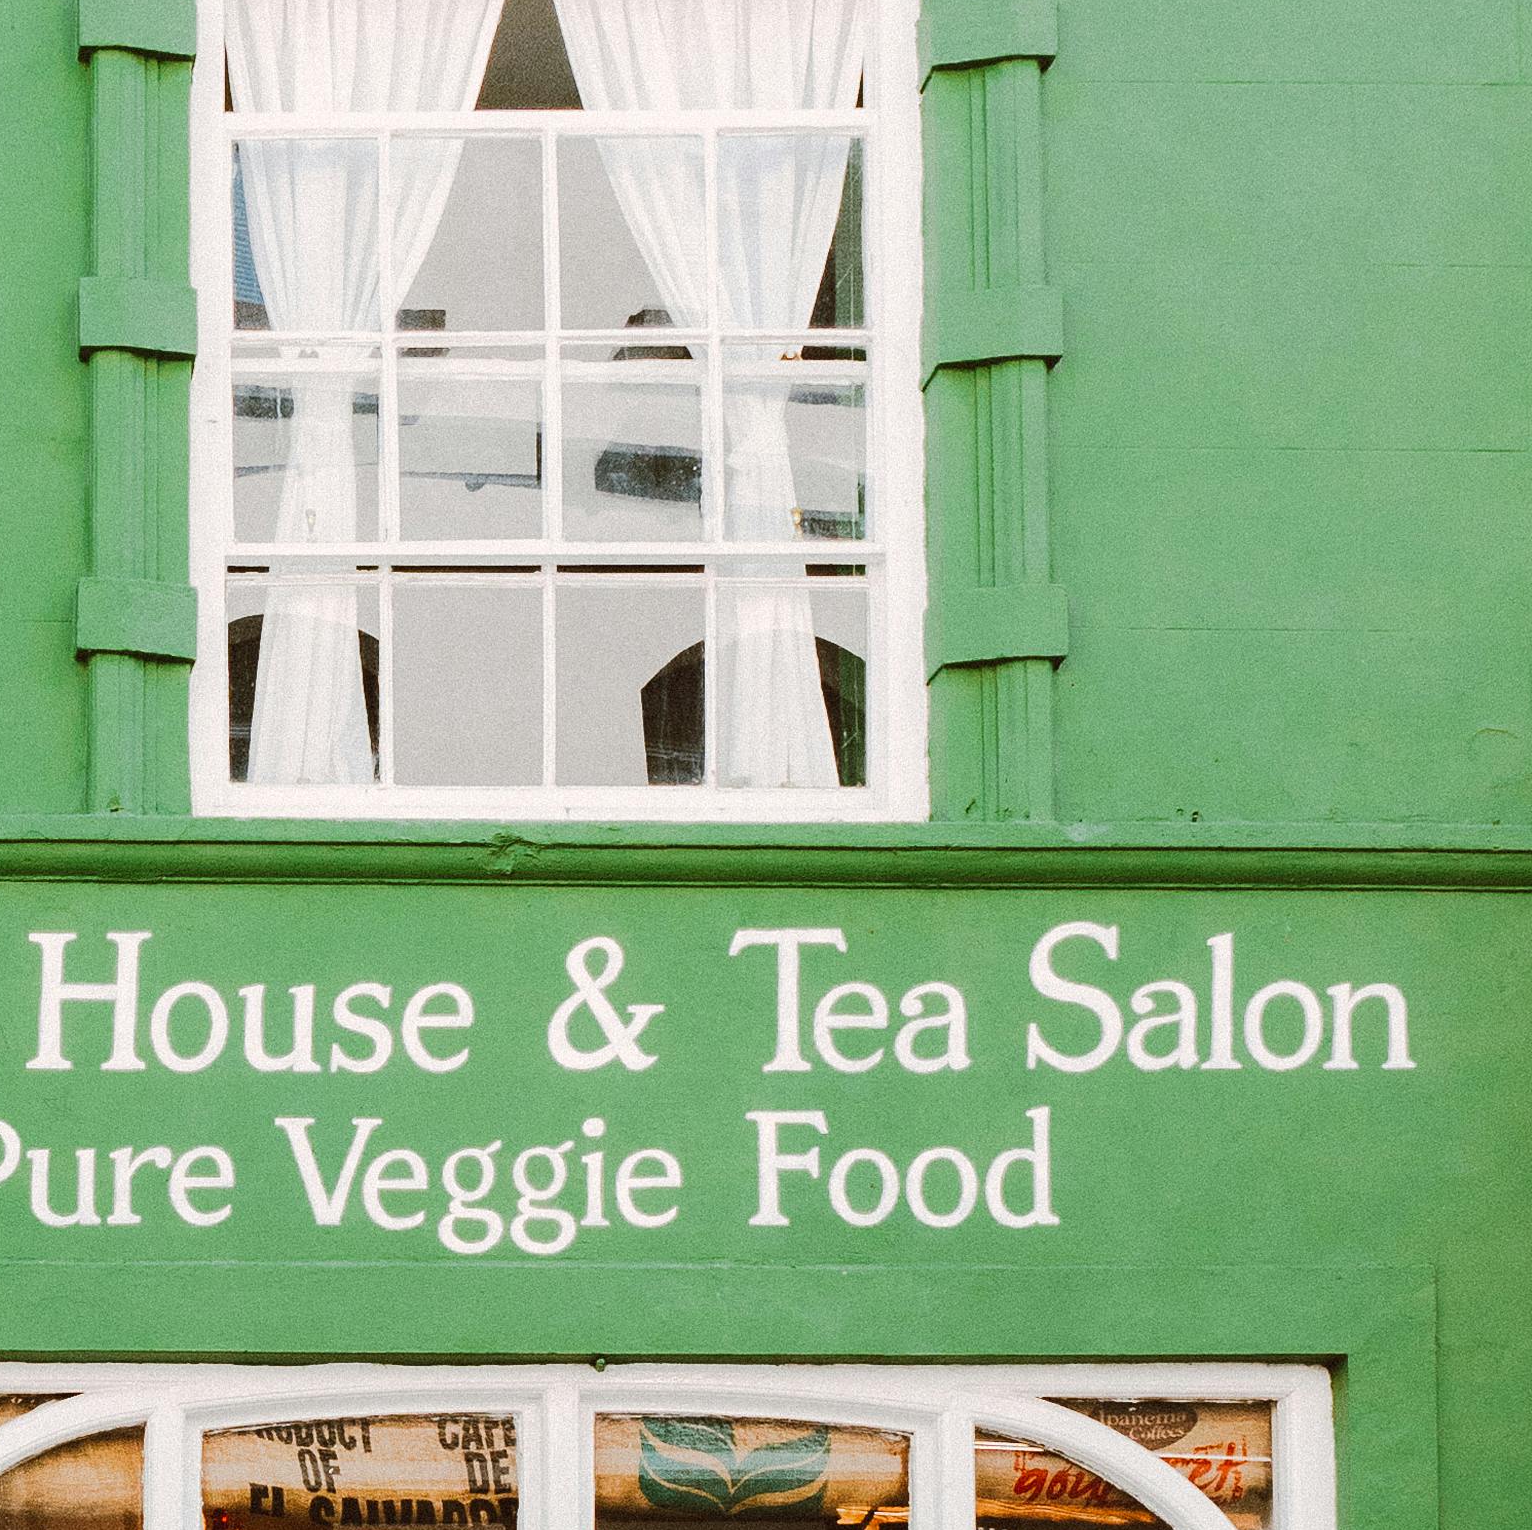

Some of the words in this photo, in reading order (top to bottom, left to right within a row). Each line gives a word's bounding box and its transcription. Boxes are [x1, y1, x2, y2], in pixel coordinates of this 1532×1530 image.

[26, 931, 474, 1073] House
[547, 936, 665, 1071] &
[729, 927, 971, 1074] Tea
[1027, 921, 1416, 1073] Salon
[275, 1117, 683, 1255] Veggie
[745, 1106, 1060, 1228] Food
[298, 1449, 340, 1493] OF
[465, 1449, 512, 1494] DE
